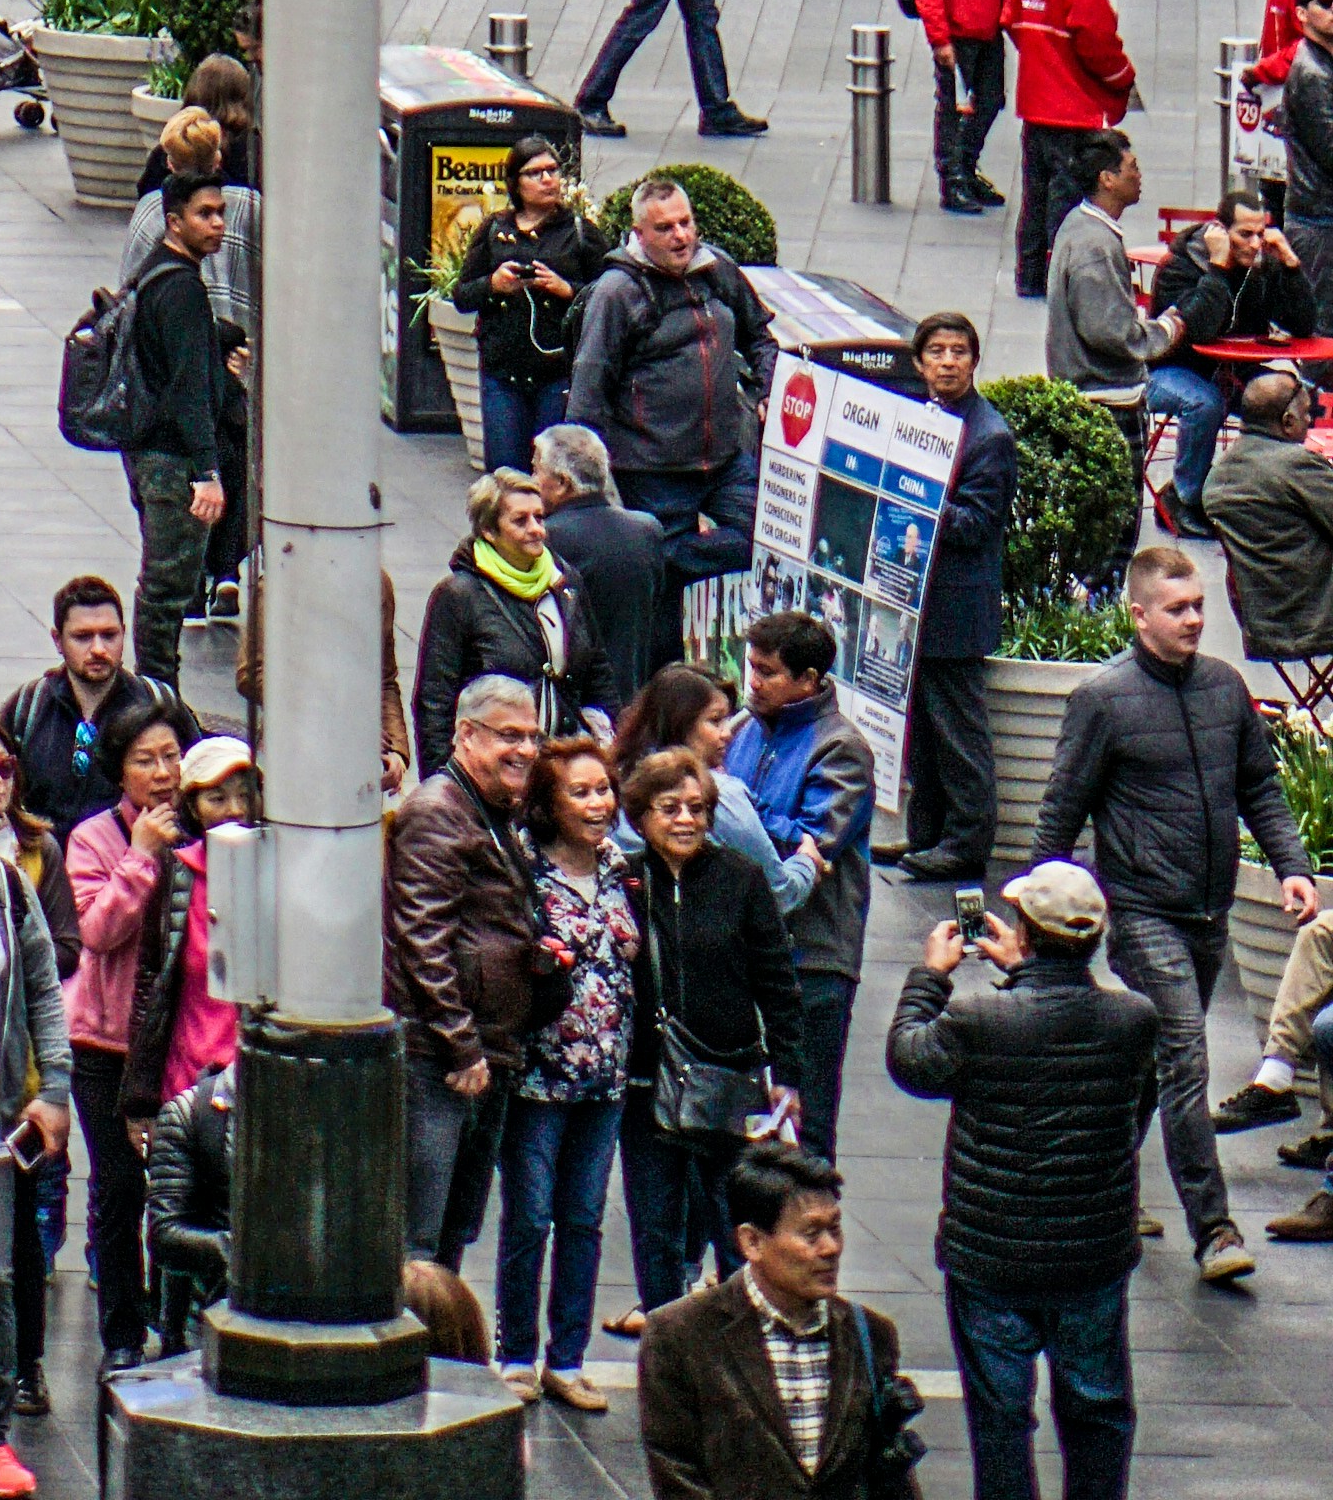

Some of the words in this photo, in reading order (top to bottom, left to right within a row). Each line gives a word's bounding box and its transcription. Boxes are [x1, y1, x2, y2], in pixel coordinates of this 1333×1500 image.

[841, 350, 895, 364] BigBelly
[783, 391, 812, 419] STOP
[841, 399, 881, 432] ORGAN
[895, 420, 955, 461] HARVESTING
[768, 458, 807, 487] MURDERING
[845, 454, 857, 470] IN
[897, 472, 926, 496] CHINA
[762, 479, 797, 508] PRISONERS
[763, 499, 803, 529] CONSCIENCE
[761, 521, 774, 538] FOR
[774, 525, 802, 550] ORGANS
